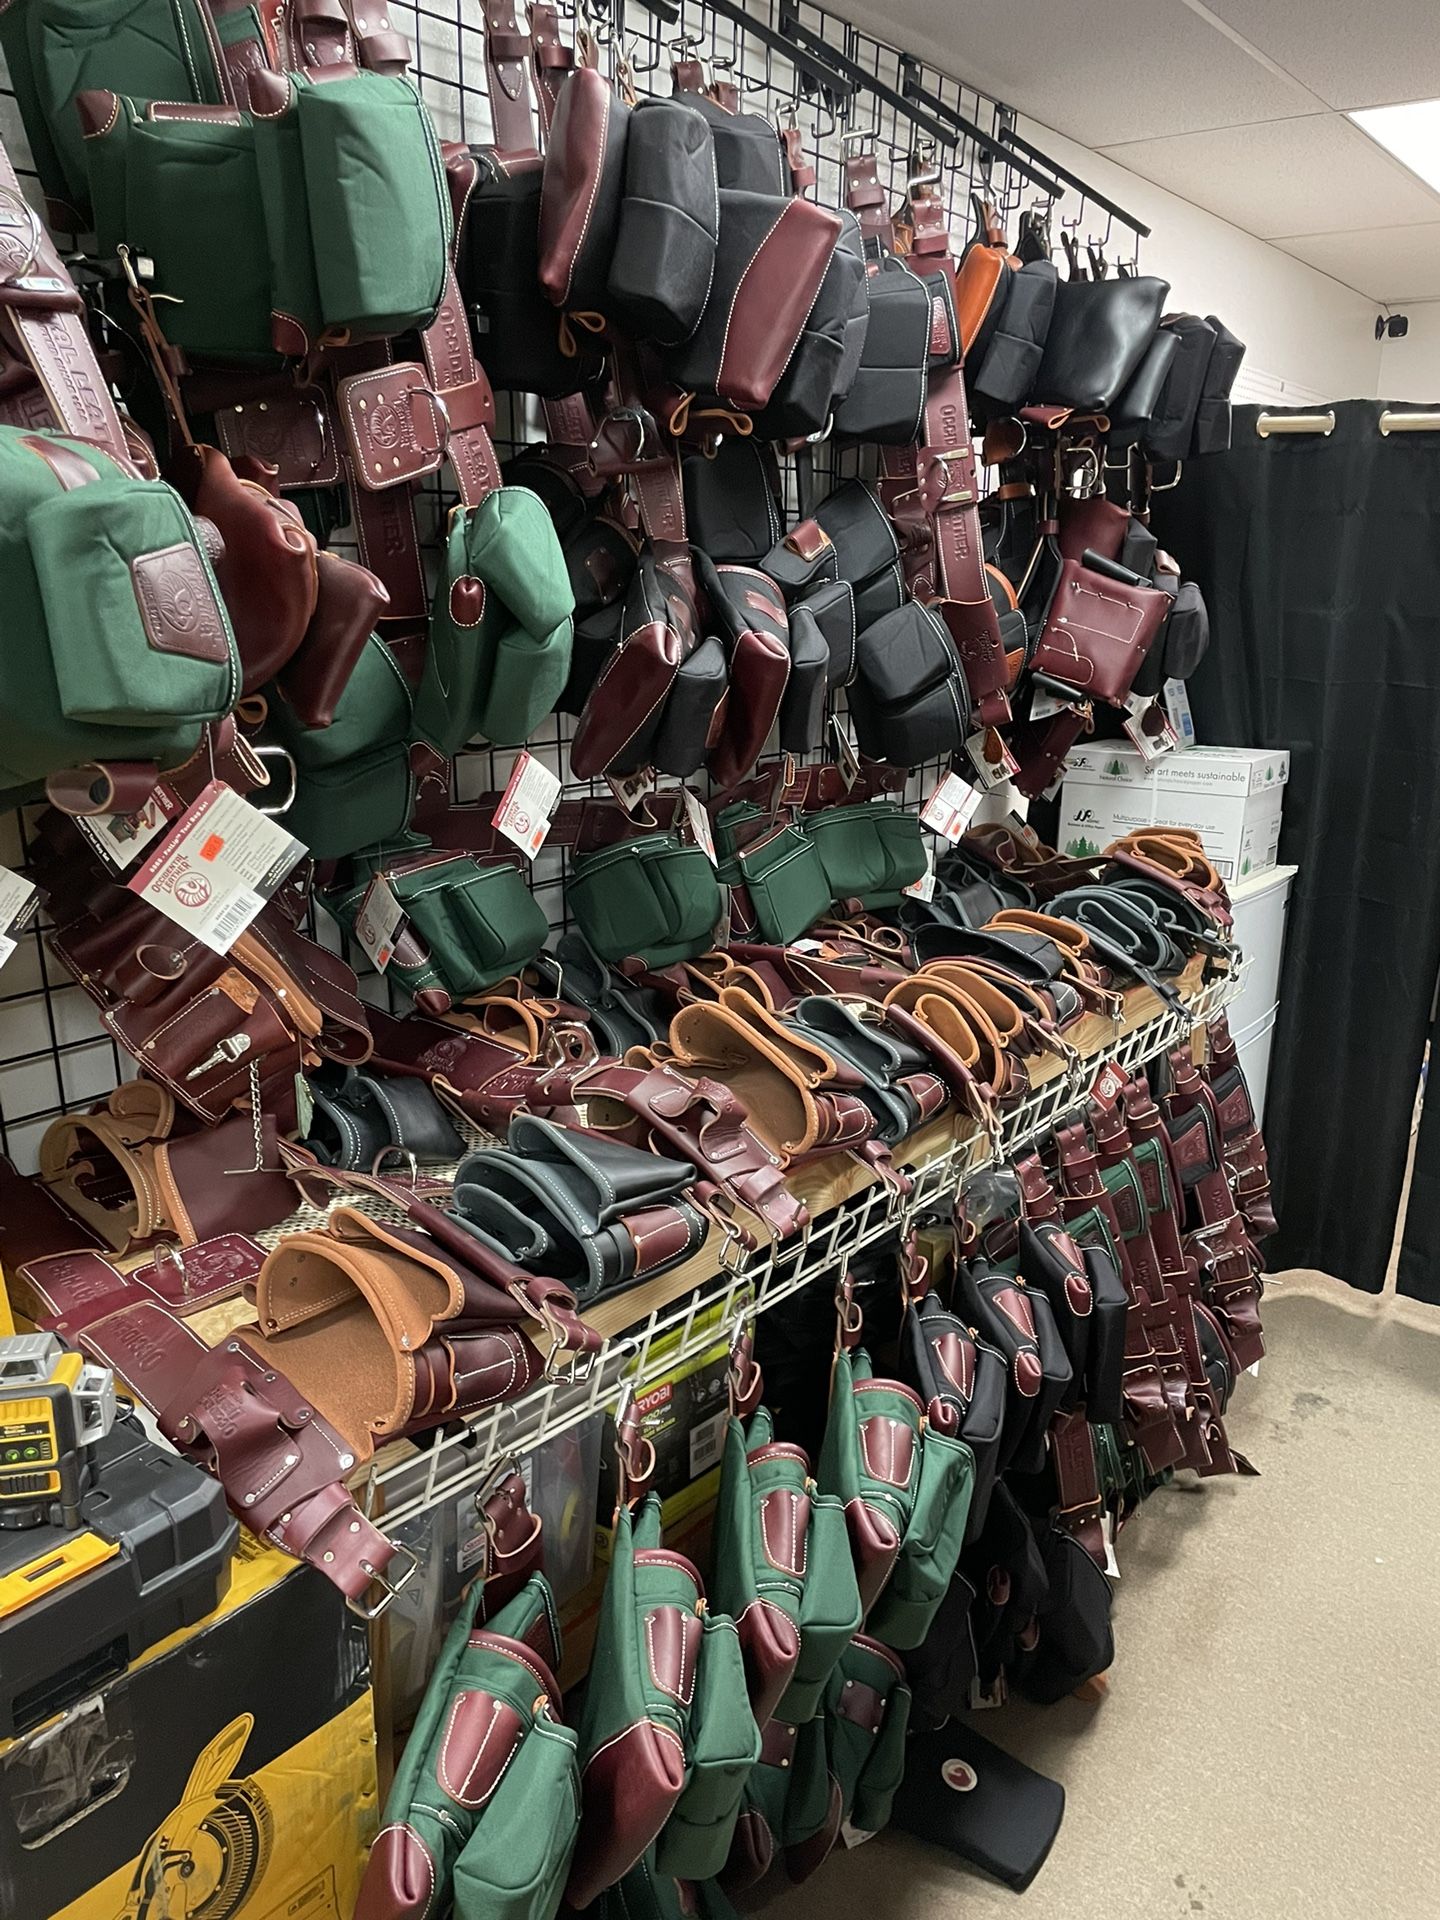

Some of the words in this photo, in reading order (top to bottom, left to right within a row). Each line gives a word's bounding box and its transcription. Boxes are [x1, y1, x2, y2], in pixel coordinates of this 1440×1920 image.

[1170, 770, 1196, 780] meets
[1197, 772, 1246, 783] sustainable
[179, 820, 192, 835] Tool
[149, 849, 188, 894] OCCIDENTAL
[160, 858, 191, 894] LEATHER
[637, 1384, 671, 1411] RYOBI
